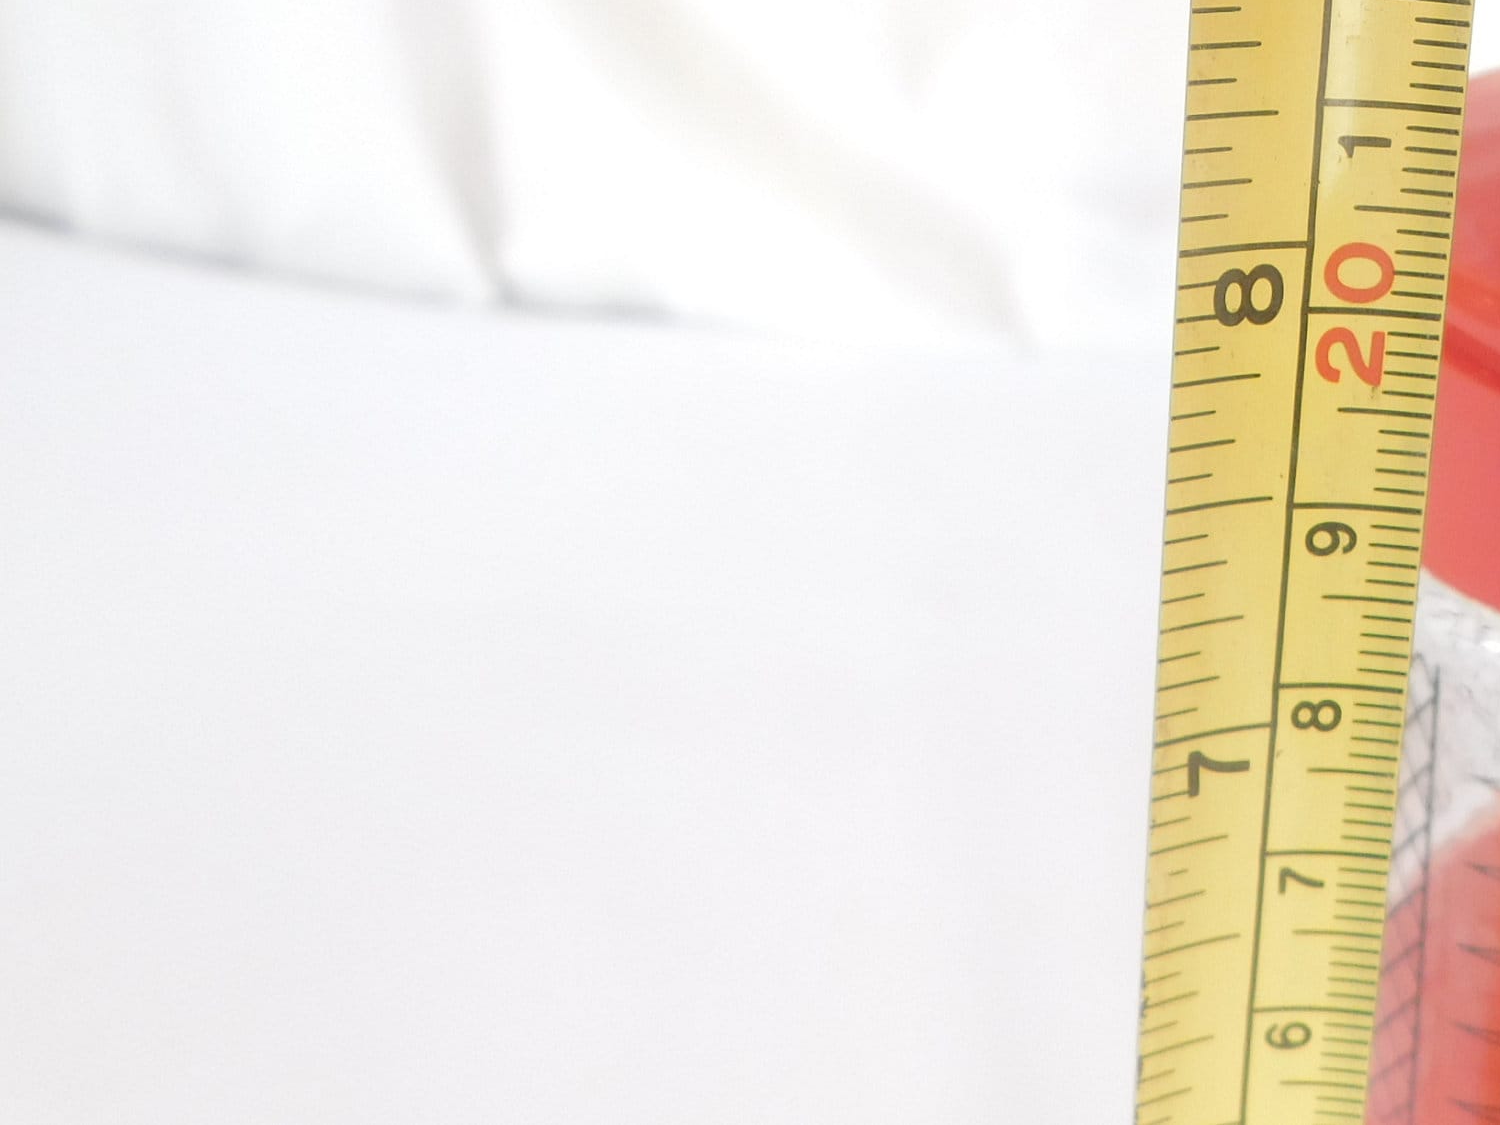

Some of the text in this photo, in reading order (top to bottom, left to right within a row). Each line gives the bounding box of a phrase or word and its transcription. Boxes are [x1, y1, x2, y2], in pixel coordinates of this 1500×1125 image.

[1338, 135, 1392, 159] 1
[1213, 264, 1284, 327] 8
[1315, 242, 1395, 387] 20
[1305, 521, 1357, 557] 9
[1291, 699, 1342, 732] 8
[1187, 750, 1250, 797] 7
[1278, 867, 1325, 895] 7
[1265, 1022, 1312, 1050] 6
